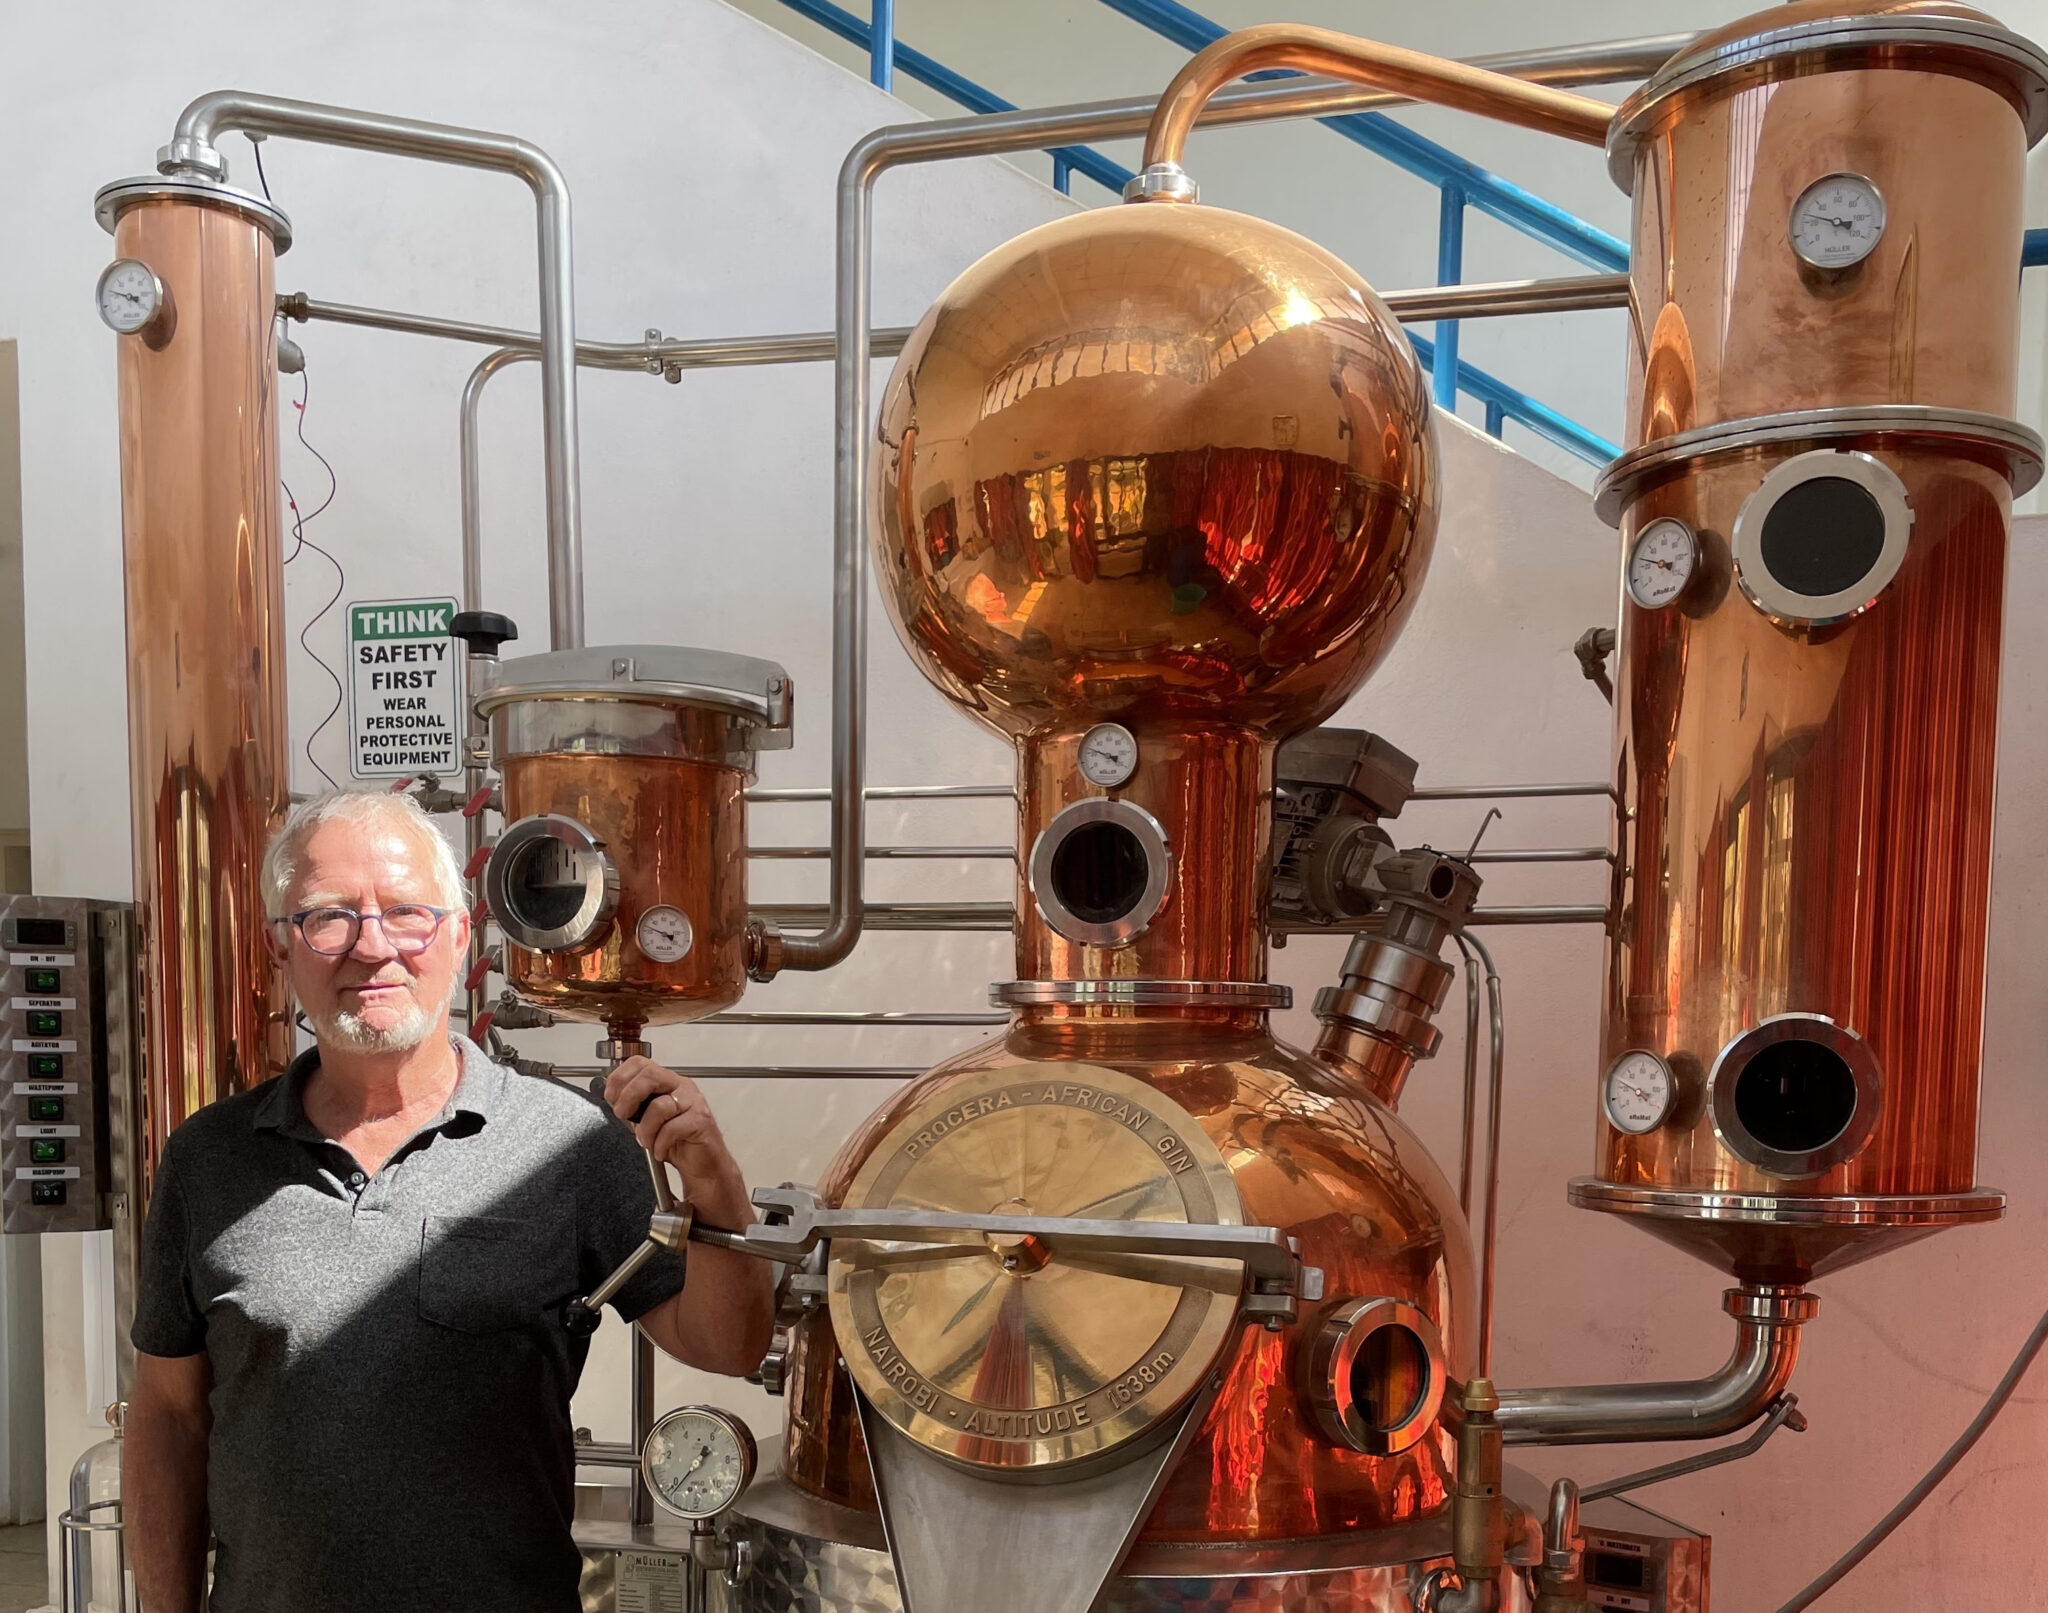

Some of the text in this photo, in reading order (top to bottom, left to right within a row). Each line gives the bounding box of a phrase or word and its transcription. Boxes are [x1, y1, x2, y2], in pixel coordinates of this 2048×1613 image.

[358, 608, 447, 635] THINK
[360, 643, 447, 664] SAFETY
[372, 670, 437, 690] FIRST
[383, 697, 427, 711] WEAR
[366, 714, 445, 730] PERSONAL
[360, 733, 453, 748] PROTECTIVE
[363, 751, 450, 767] EQUIPMENT
[904, 1094, 1013, 1160] PROCERA
[1042, 1085, 1150, 1131] AFRICAN
[1156, 1135, 1194, 1175] GIN
[864, 1326, 940, 1413] NAIROBI
[964, 1402, 1091, 1437] ALTITUDE
[1106, 1350, 1175, 1410] 1638m
[709, 1432, 715, 1441] 6
[666, 1450, 672, 1459] 2
[673, 1476, 679, 1486] 0
[636, 1555, 666, 1567] MÜLLER
